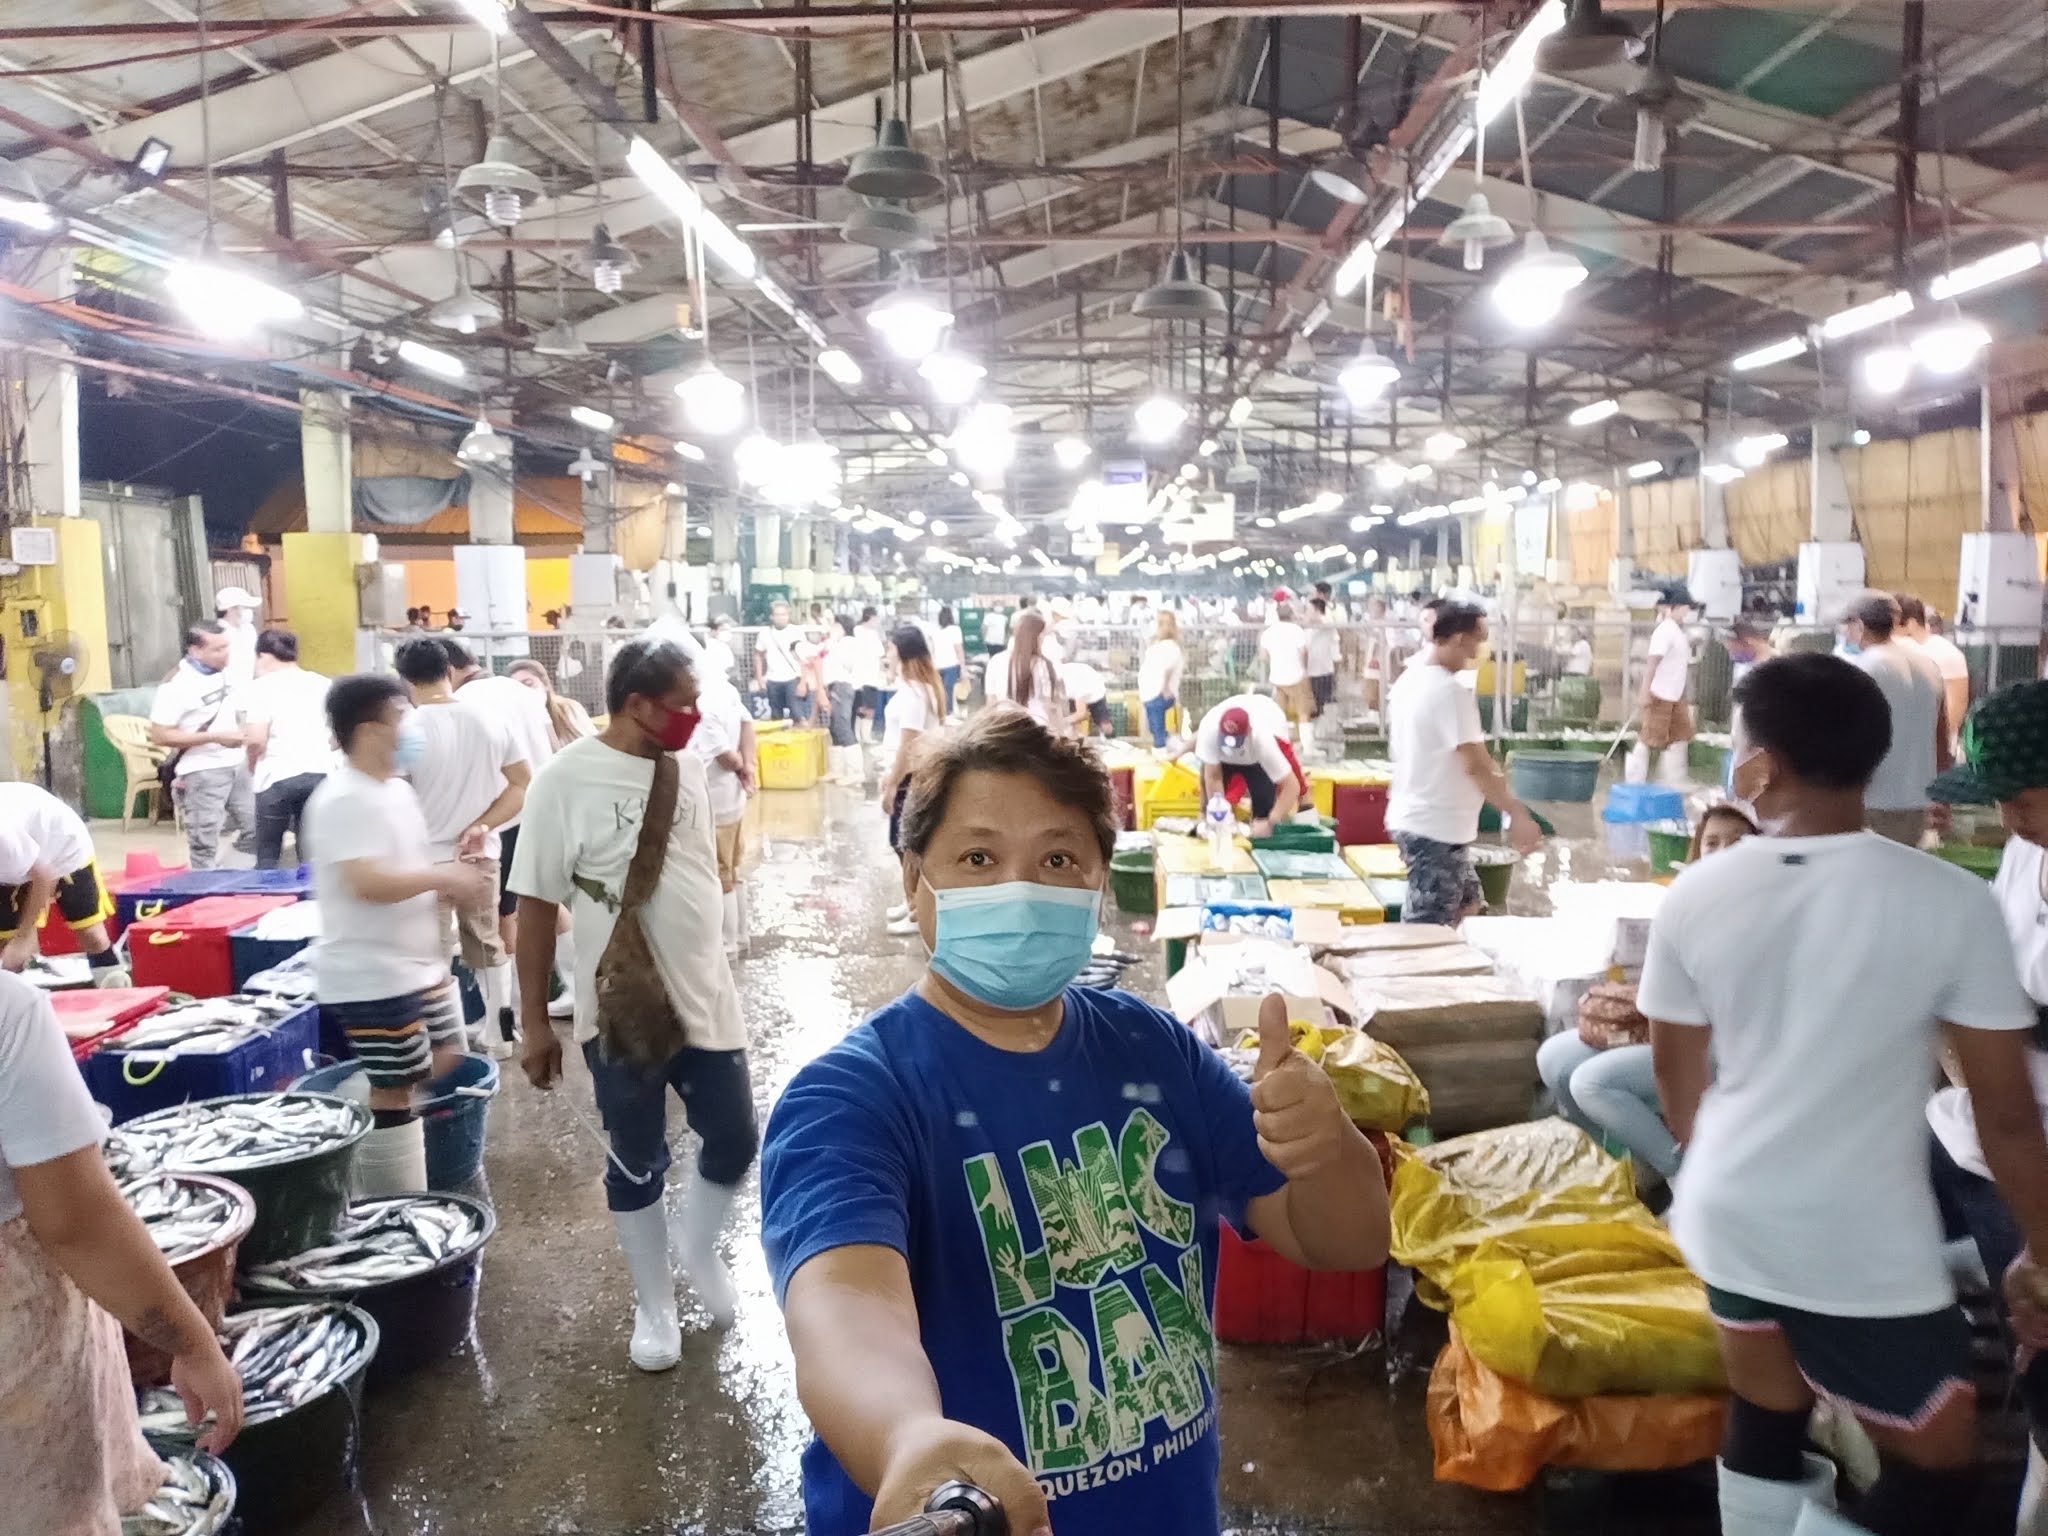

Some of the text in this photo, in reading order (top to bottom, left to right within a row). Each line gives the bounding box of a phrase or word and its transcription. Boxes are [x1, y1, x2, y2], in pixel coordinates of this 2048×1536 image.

[963, 1107, 1195, 1316] LUC
[1001, 1243, 1217, 1475] BAN
[1153, 1407, 1215, 1465] PHILIPP
